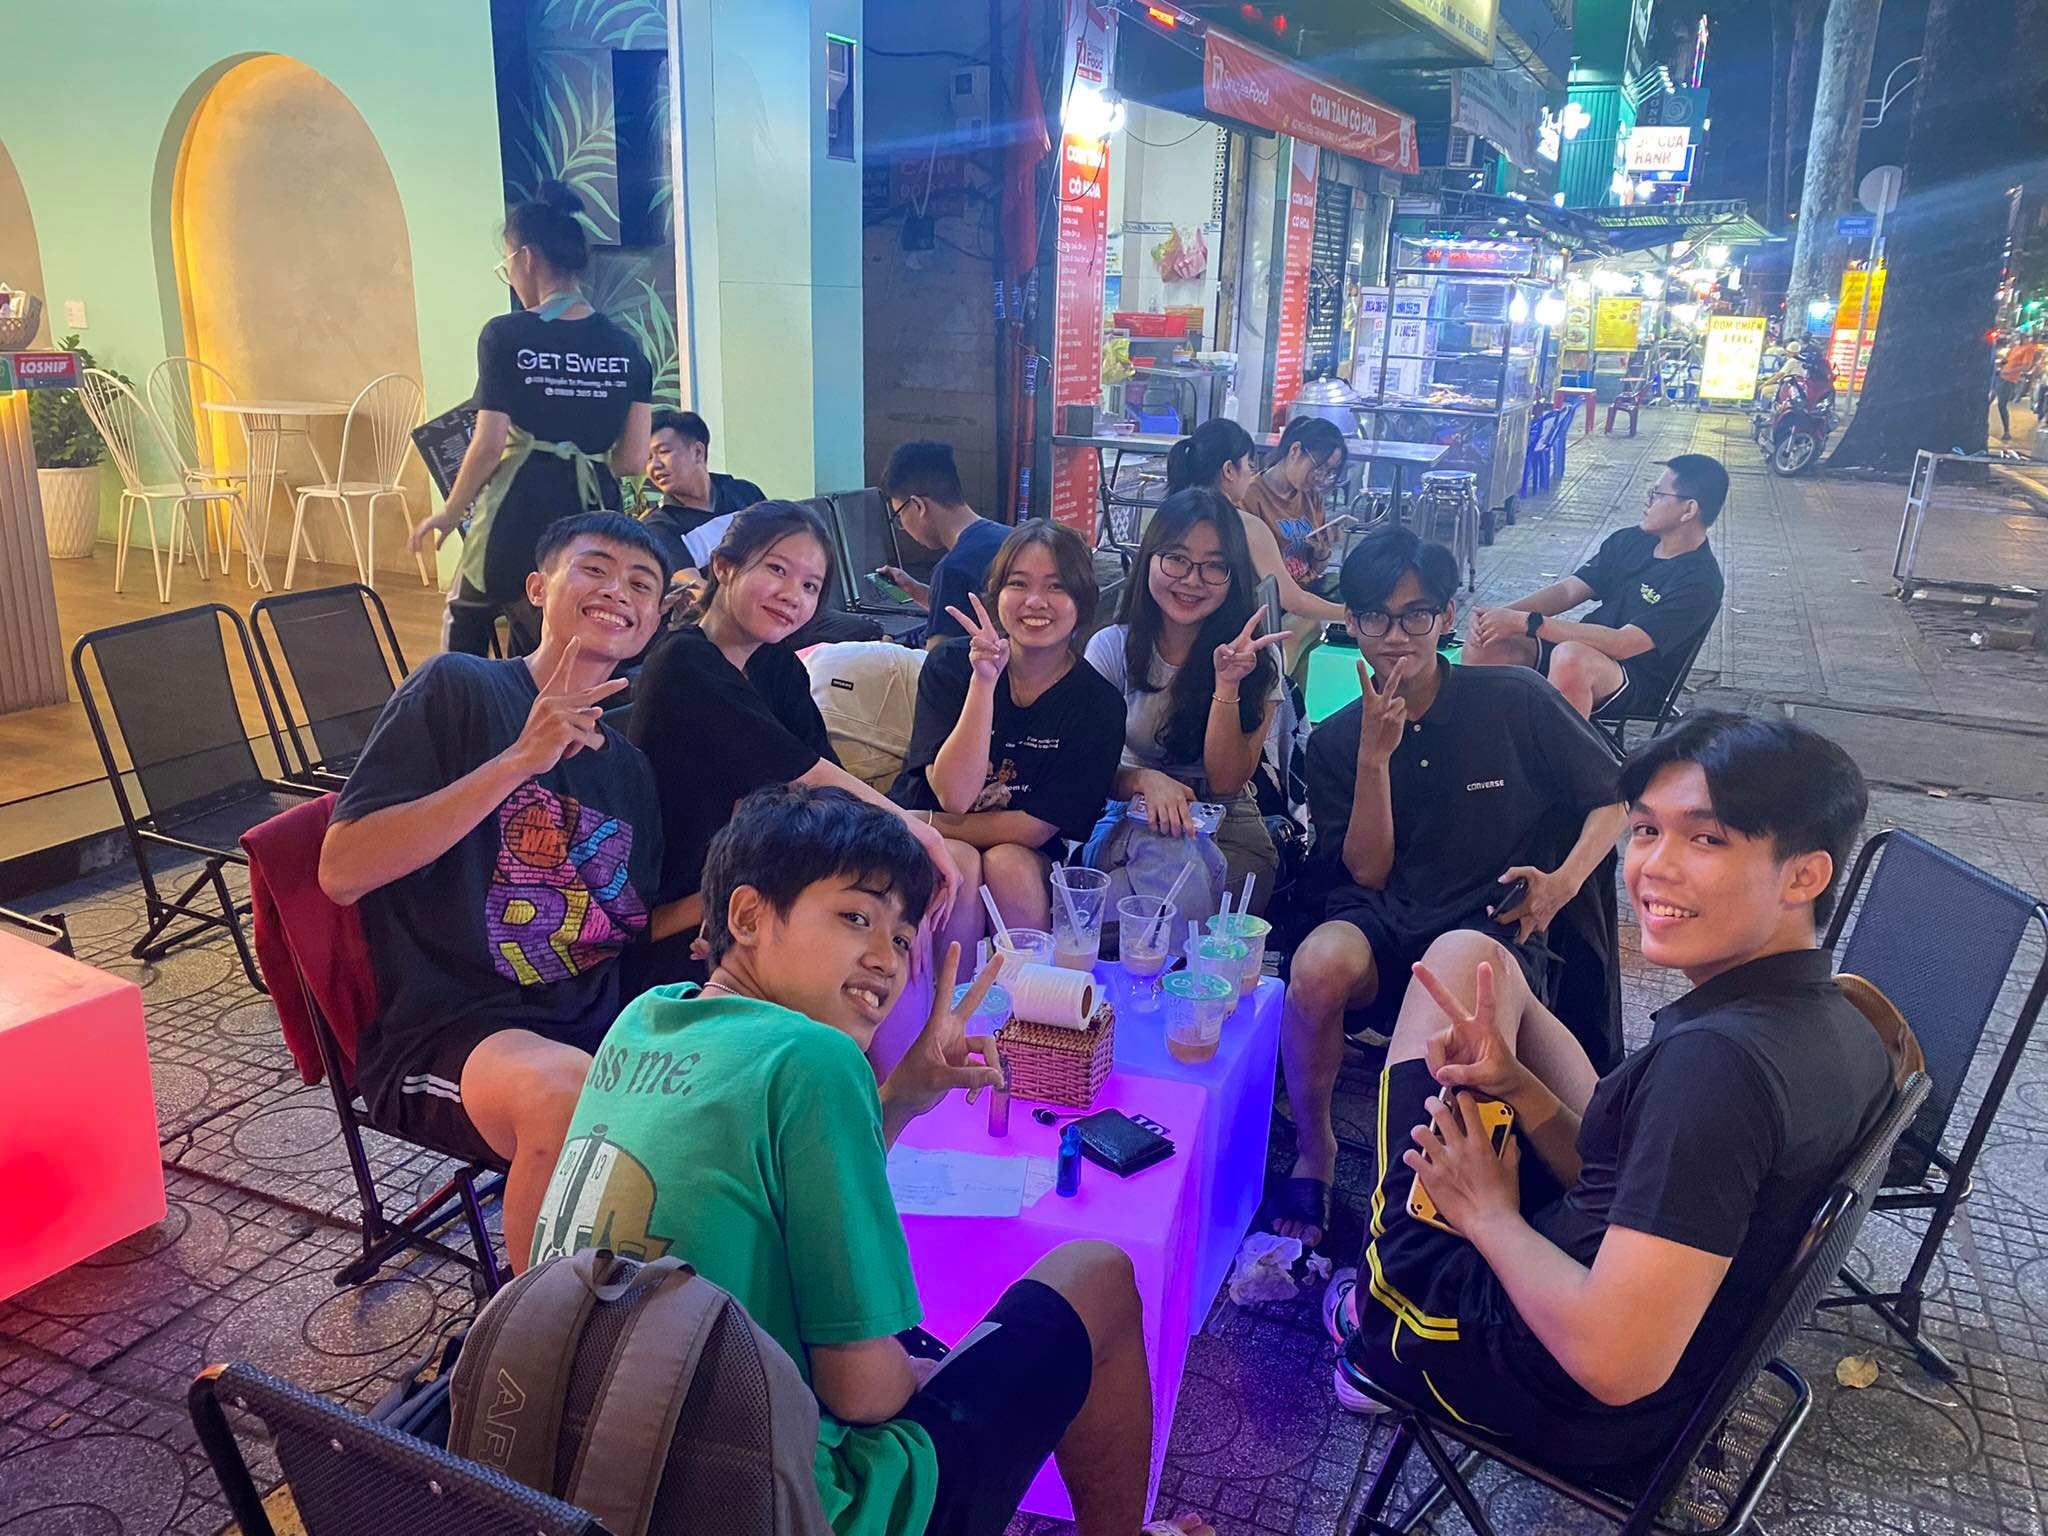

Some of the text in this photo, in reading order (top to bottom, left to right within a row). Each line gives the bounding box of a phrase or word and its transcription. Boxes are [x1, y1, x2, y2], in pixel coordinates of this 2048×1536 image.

[1361, 113, 1377, 138] HOA
[20, 361, 68, 374] LOSHIP
[517, 348, 630, 373] GET SWEET
[1466, 779, 1505, 791] CONVERSE
[625, 1050, 701, 1097] me.
[591, 1153, 608, 1180] 13
